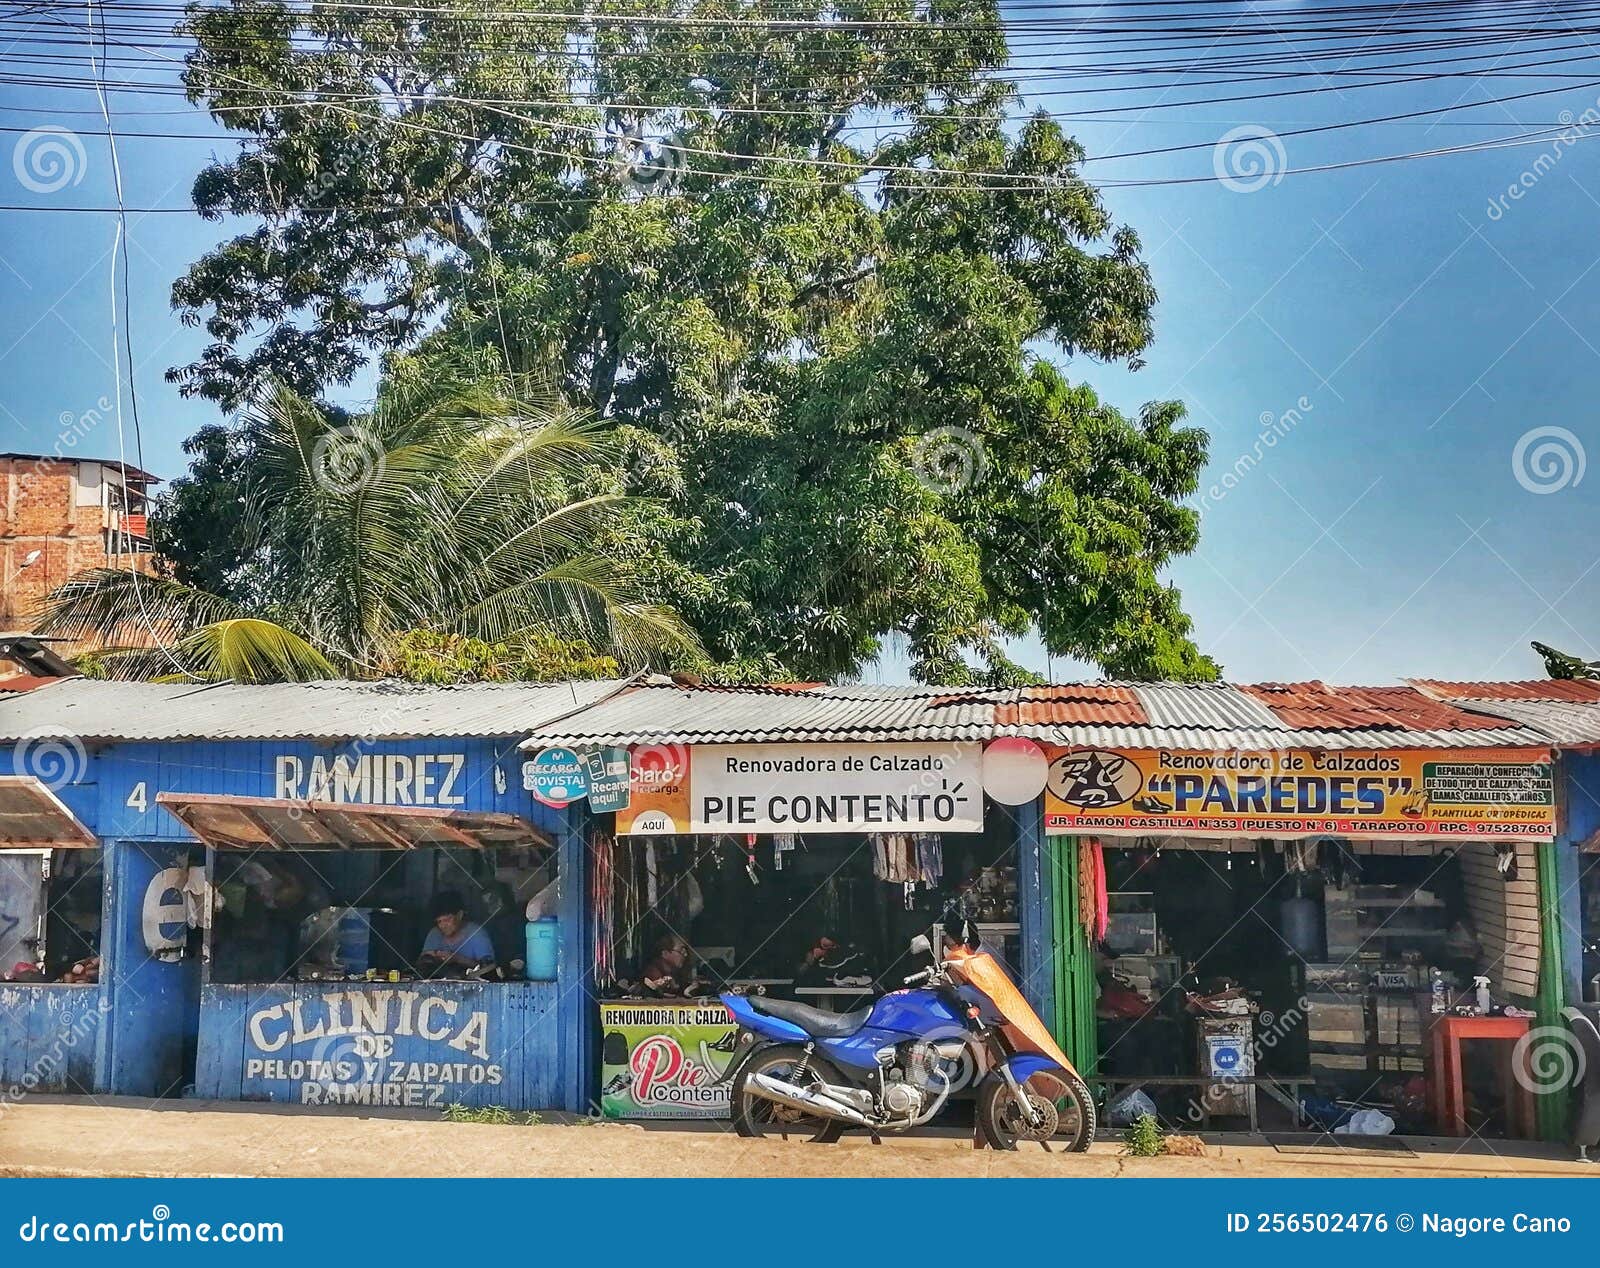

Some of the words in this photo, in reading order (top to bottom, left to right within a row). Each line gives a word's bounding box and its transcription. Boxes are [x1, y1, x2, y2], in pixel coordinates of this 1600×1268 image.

[527, 764, 582, 774] RECARGA
[727, 756, 836, 773] Renovadora
[842, 756, 864, 772] de
[870, 755, 943, 771] Calzado
[1159, 751, 1271, 770] Renovadora
[1280, 752, 1304, 770] de
[1313, 753, 1400, 771] Calzados
[276, 754, 465, 805] RAMIREZ
[631, 766, 674, 783] Claro
[1486, 766, 1492, 776] Y
[638, 785, 679, 795] recarga
[1426, 779, 1436, 788] DE
[1438, 779, 1458, 788] TODO
[1460, 779, 1477, 788] TIPO
[1479, 779, 1489, 788] DE
[1532, 780, 1551, 789] PARA
[126, 781, 147, 812] 4
[704, 796, 756, 824] PIE
[768, 794, 954, 823] CONTENTO
[1432, 809, 1484, 818] PLANTILLAS
[1487, 808, 1547, 819] ORTOPÉDICAS
[1050, 817, 1071, 825] JR.
[1076, 815, 1125, 826] RAMÓN
[1130, 817, 1194, 827] CASTILLA
[1242, 820, 1302, 830] (PUESTO
[1325, 821, 1337, 831] 6)
[1351, 821, 1426, 831] TARAPOTO
[1440, 823, 1472, 832] RPC.
[1477, 823, 1551, 833] 975287601
[250, 990, 490, 1061] CLINICA
[606, 1009, 675, 1025] RENOVADORA
[679, 1009, 692, 1025] DE
[353, 1035, 393, 1058] DE
[247, 1059, 352, 1081] PELOTAS
[364, 1061, 379, 1081] Y
[389, 1062, 503, 1085] ZAPATOS
[632, 1037, 705, 1100] Pie
[302, 1081, 446, 1107] RAMIREZ
